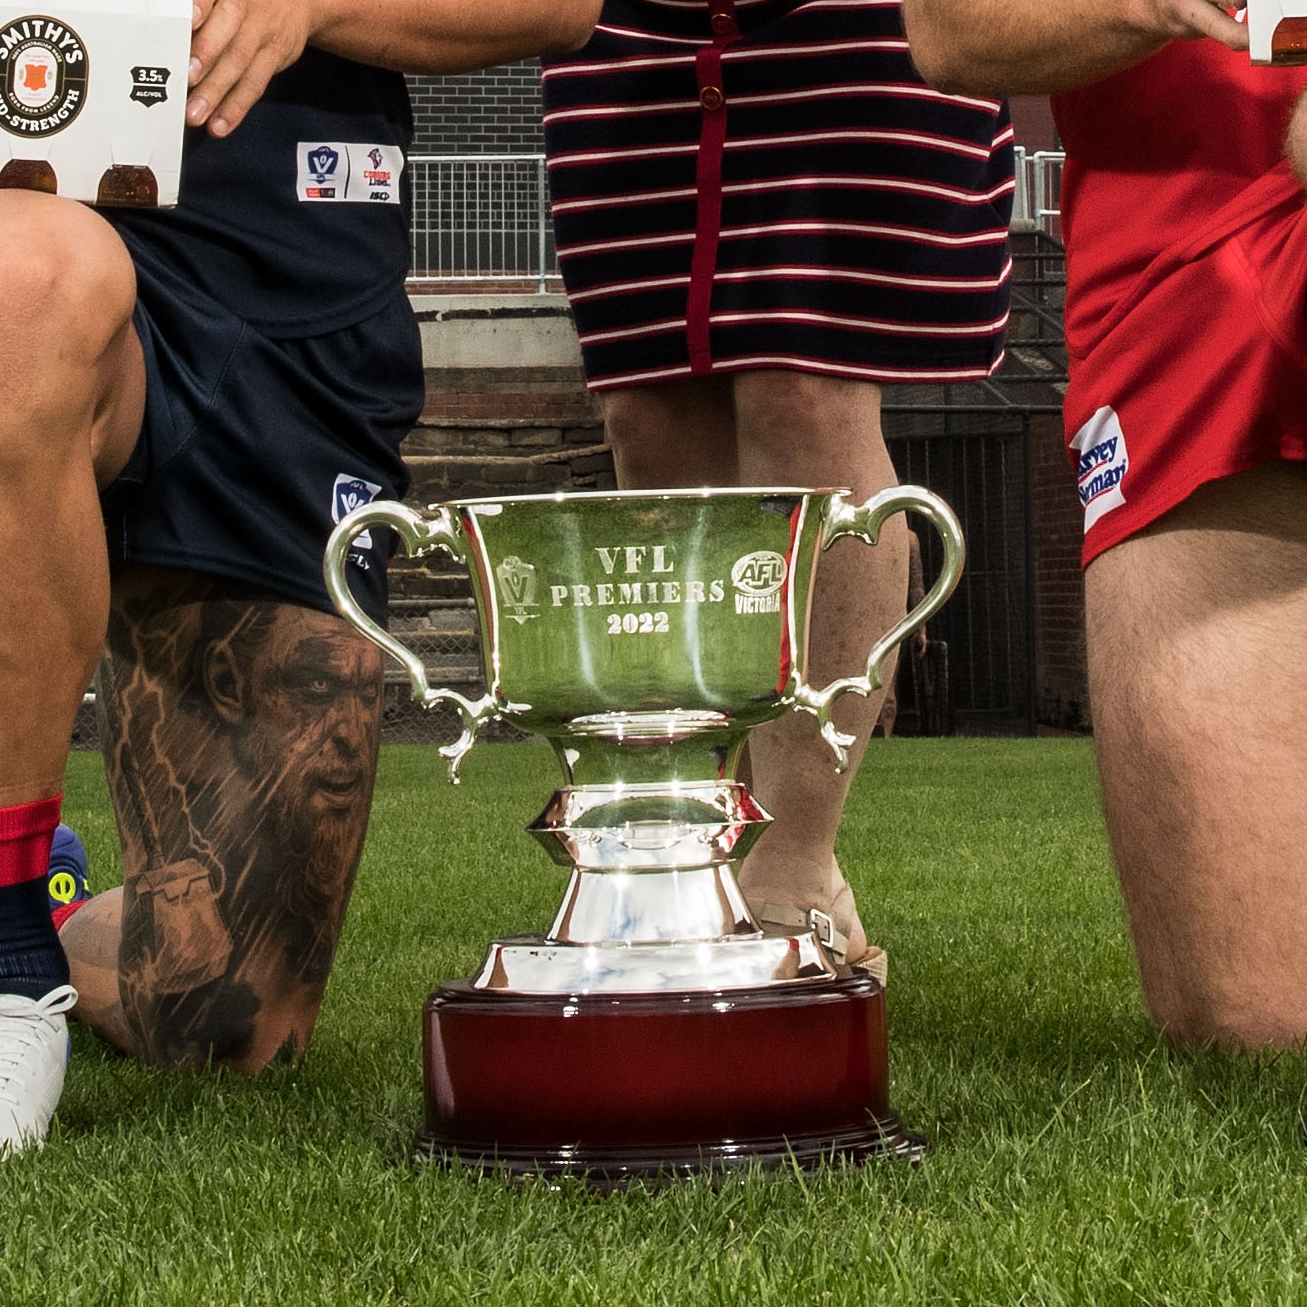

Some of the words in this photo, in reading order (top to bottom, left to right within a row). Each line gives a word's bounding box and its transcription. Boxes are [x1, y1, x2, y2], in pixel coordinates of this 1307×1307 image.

[594, 545, 674, 574] VFL
[743, 560, 784, 586] AFL
[551, 579, 724, 607] PREMIERS
[735, 592, 780, 614] VICTORIA
[607, 612, 669, 634] 2022
